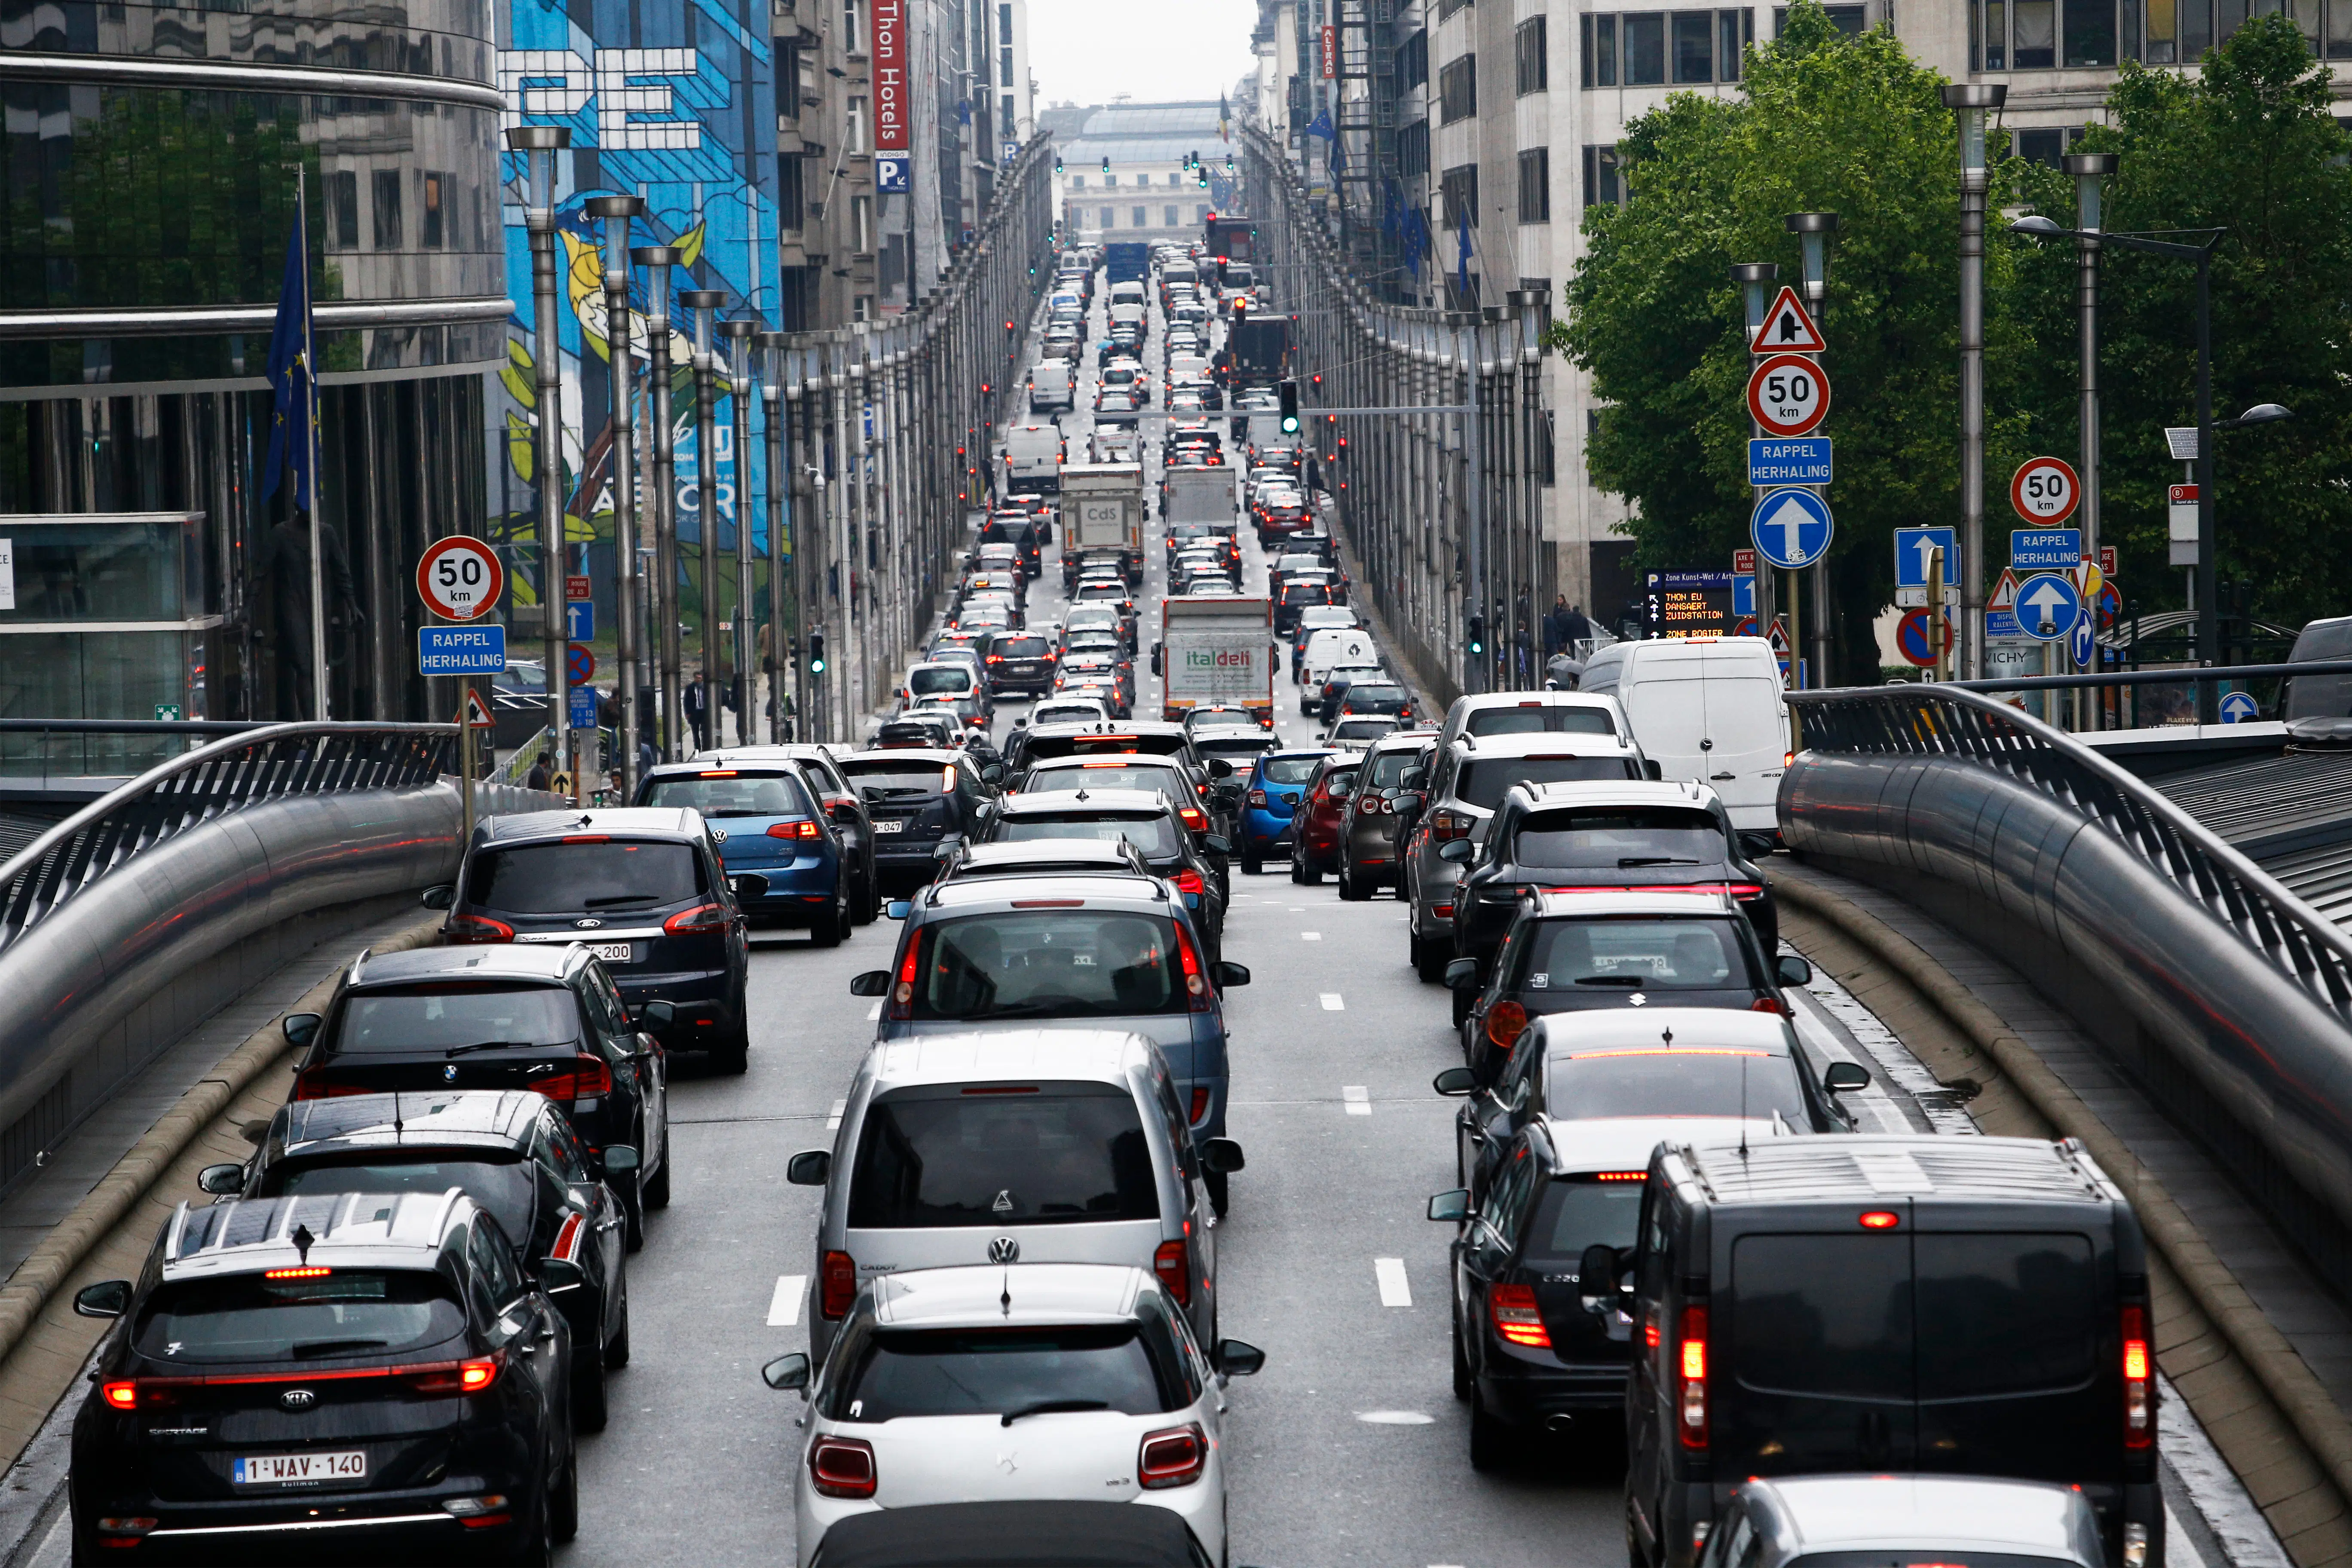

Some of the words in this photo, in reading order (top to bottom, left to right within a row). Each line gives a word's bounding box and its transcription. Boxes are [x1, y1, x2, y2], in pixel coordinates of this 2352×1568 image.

[878, 1, 898, 58] Thon
[1324, 29, 1333, 74] ALTRAD
[880, 68, 901, 140] Hotels
[879, 161, 897, 186] P
[1769, 375, 1809, 403] 50
[1779, 407, 1799, 417] km
[1763, 445, 1817, 458] RAPPEL
[1752, 465, 1829, 479] HERHALING
[2029, 475, 2063, 498] 50
[2037, 501, 2054, 510] km
[1087, 508, 1116, 520] CdS
[2023, 536, 2069, 546] RAPPEL
[2014, 552, 2079, 564] HERHALING
[438, 558, 481, 587] 50
[450, 590, 470, 601] km
[1666, 593, 1687, 601] THON
[1691, 593, 1702, 601] EU
[1665, 602, 1707, 611] DANSAERT
[1665, 611, 1723, 620] ZUIDSTATION
[433, 634, 490, 646] RAPPEL
[422, 654, 502, 668] HERHALING
[1187, 650, 1250, 666] italdeli
[1985, 652, 2027, 663] VICHY
[285, 1393, 309, 1404] KIA
